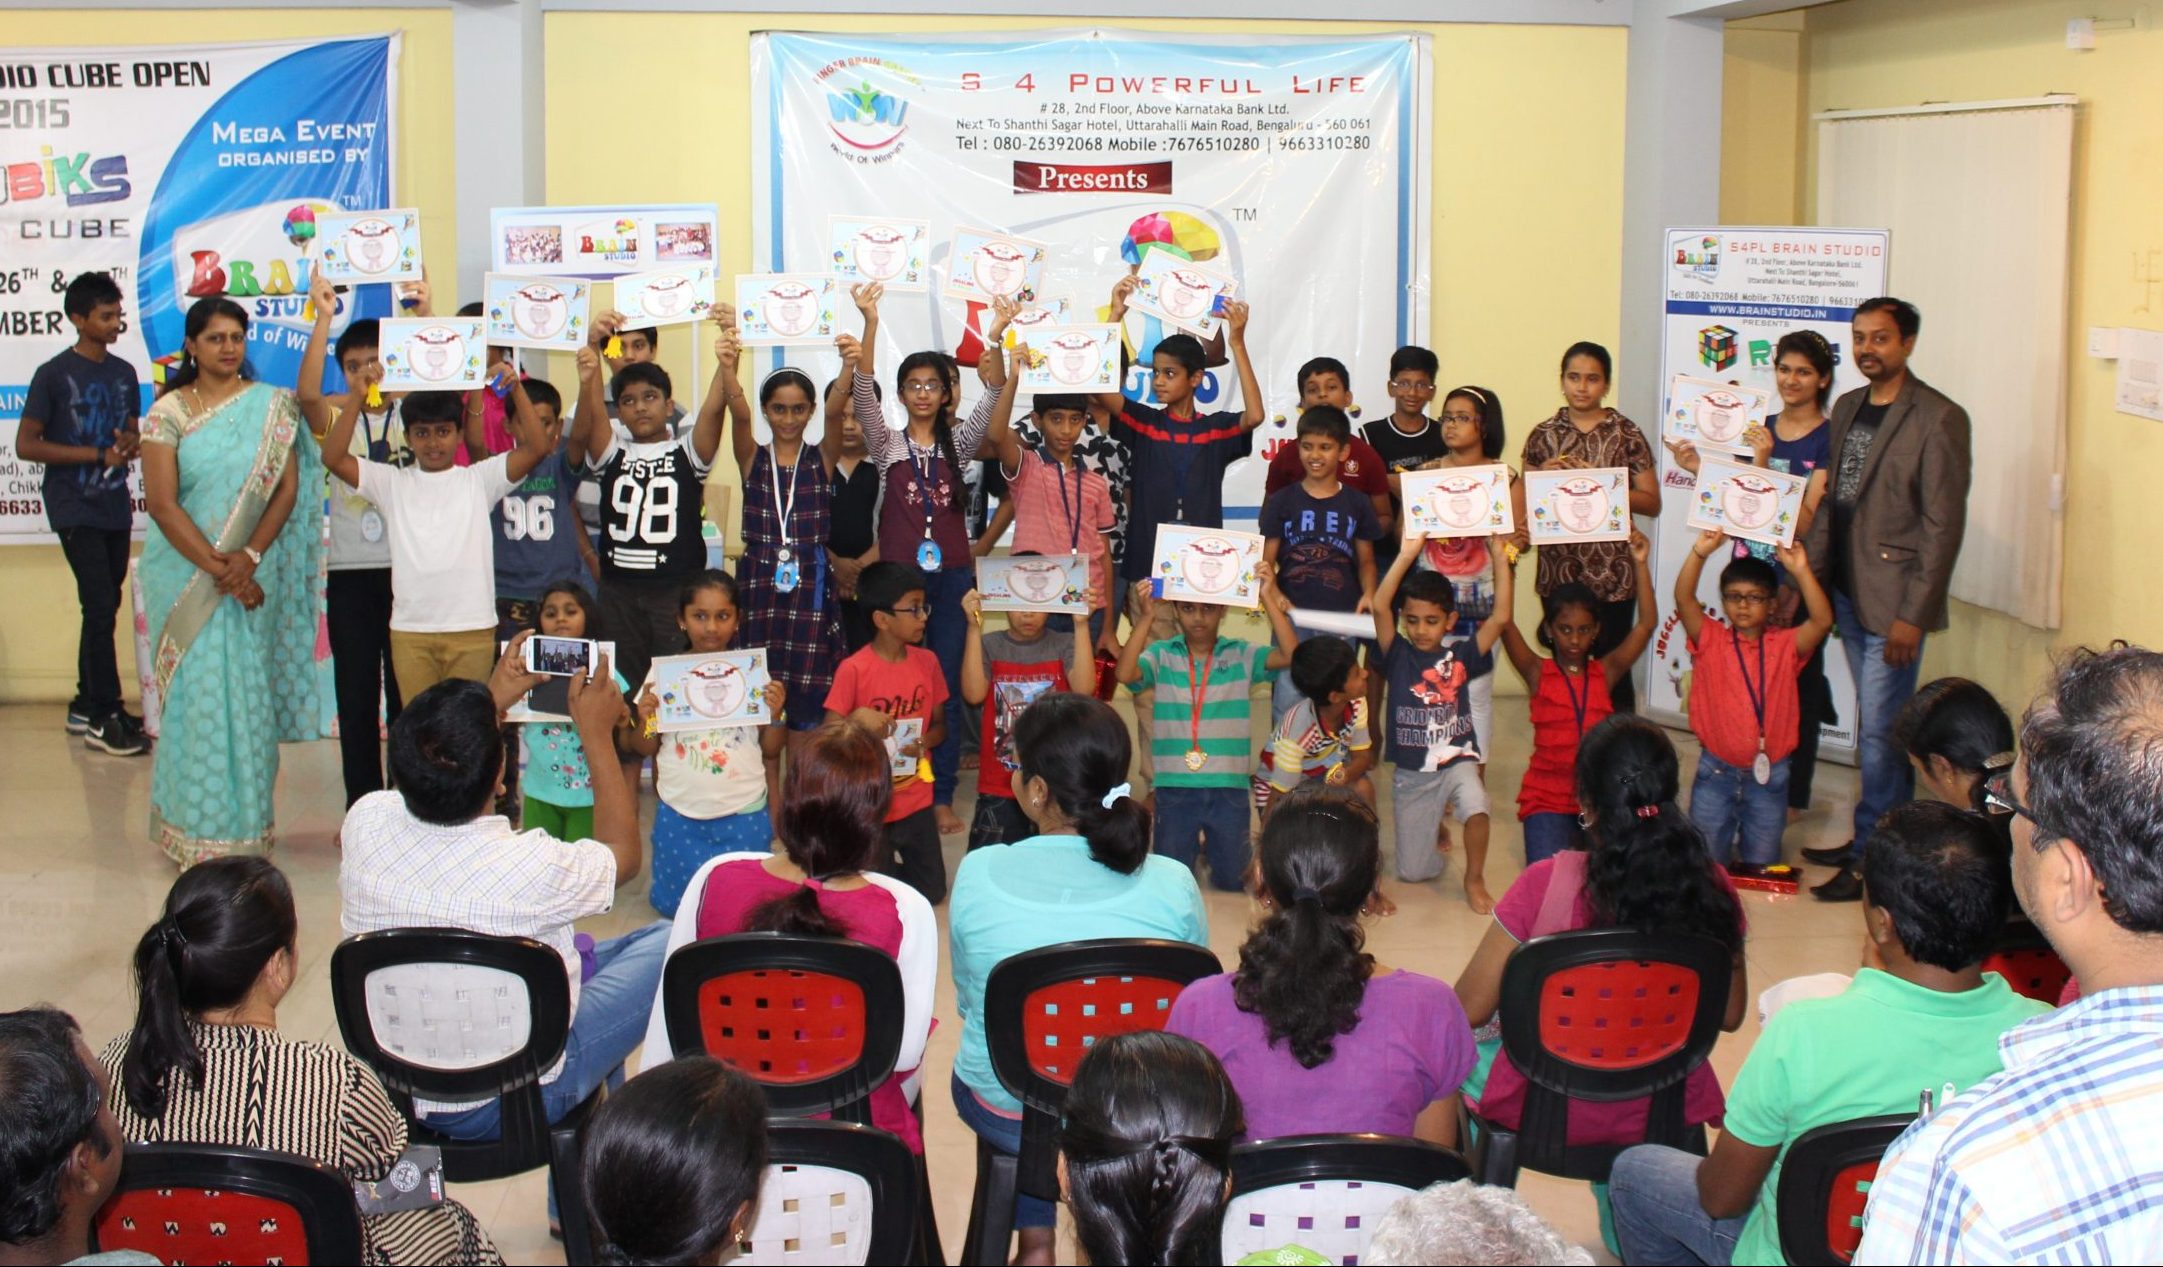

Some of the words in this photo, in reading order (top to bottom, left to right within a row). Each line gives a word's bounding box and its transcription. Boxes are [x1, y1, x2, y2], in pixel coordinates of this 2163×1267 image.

[48, 63, 123, 89] CUBE
[133, 61, 211, 88] OPEN
[960, 72, 981, 92] S
[1015, 73, 1036, 93] 4
[1069, 73, 1263, 95] POWERFUL
[1292, 74, 1366, 94] LIFE
[1040, 103, 1048, 114] #
[1052, 103, 1070, 116] 28,
[1074, 103, 1096, 114] 2nd
[1099, 103, 1132, 116] Floor,
[1136, 104, 1173, 115] Above
[1176, 104, 1233, 115] Karnataka
[1237, 104, 1264, 115] Bank
[1268, 104, 1290, 115] Ltd.
[956, 119, 983, 131] Next
[988, 119, 1000, 130] To
[1004, 119, 1048, 131] Shanthi
[1052, 120, 1082, 133] Sagar
[1087, 119, 1121, 132] Hotel,
[1126, 120, 1187, 132] Uttarahalli
[1191, 121, 1217, 132] Main
[1221, 121, 1252, 133] Road,
[1257, 120, 1313, 134] Bengaluu
[1350, 118, 1371, 130] 061
[956, 136, 978, 150] Tel
[994, 136, 1103, 151] 080-26392068
[1108, 137, 1157, 151] Mobile
[1280, 135, 1371, 151] 9663310280
[218, 149, 335, 168] ORGANISED
[345, 147, 370, 163] BY
[1038, 165, 1149, 190] Presents
[1232, 208, 1257, 222] TM
[21, 219, 130, 239] CUBE
[580, 235, 638, 253] BRAIN
[1730, 242, 1767, 253] S4PL
[1772, 243, 1816, 254] BRAIN
[1823, 244, 1881, 257] STUDIO
[604, 253, 636, 261] STUDIO
[50, 269, 68, 294] &
[187, 249, 312, 297] BRAI
[1709, 305, 1827, 319] WWW.BRAINSTUDIO.IN
[1742, 319, 1790, 327] PRESENTS
[264, 326, 283, 345] of
[503, 495, 555, 541] 96
[608, 474, 679, 544] 98
